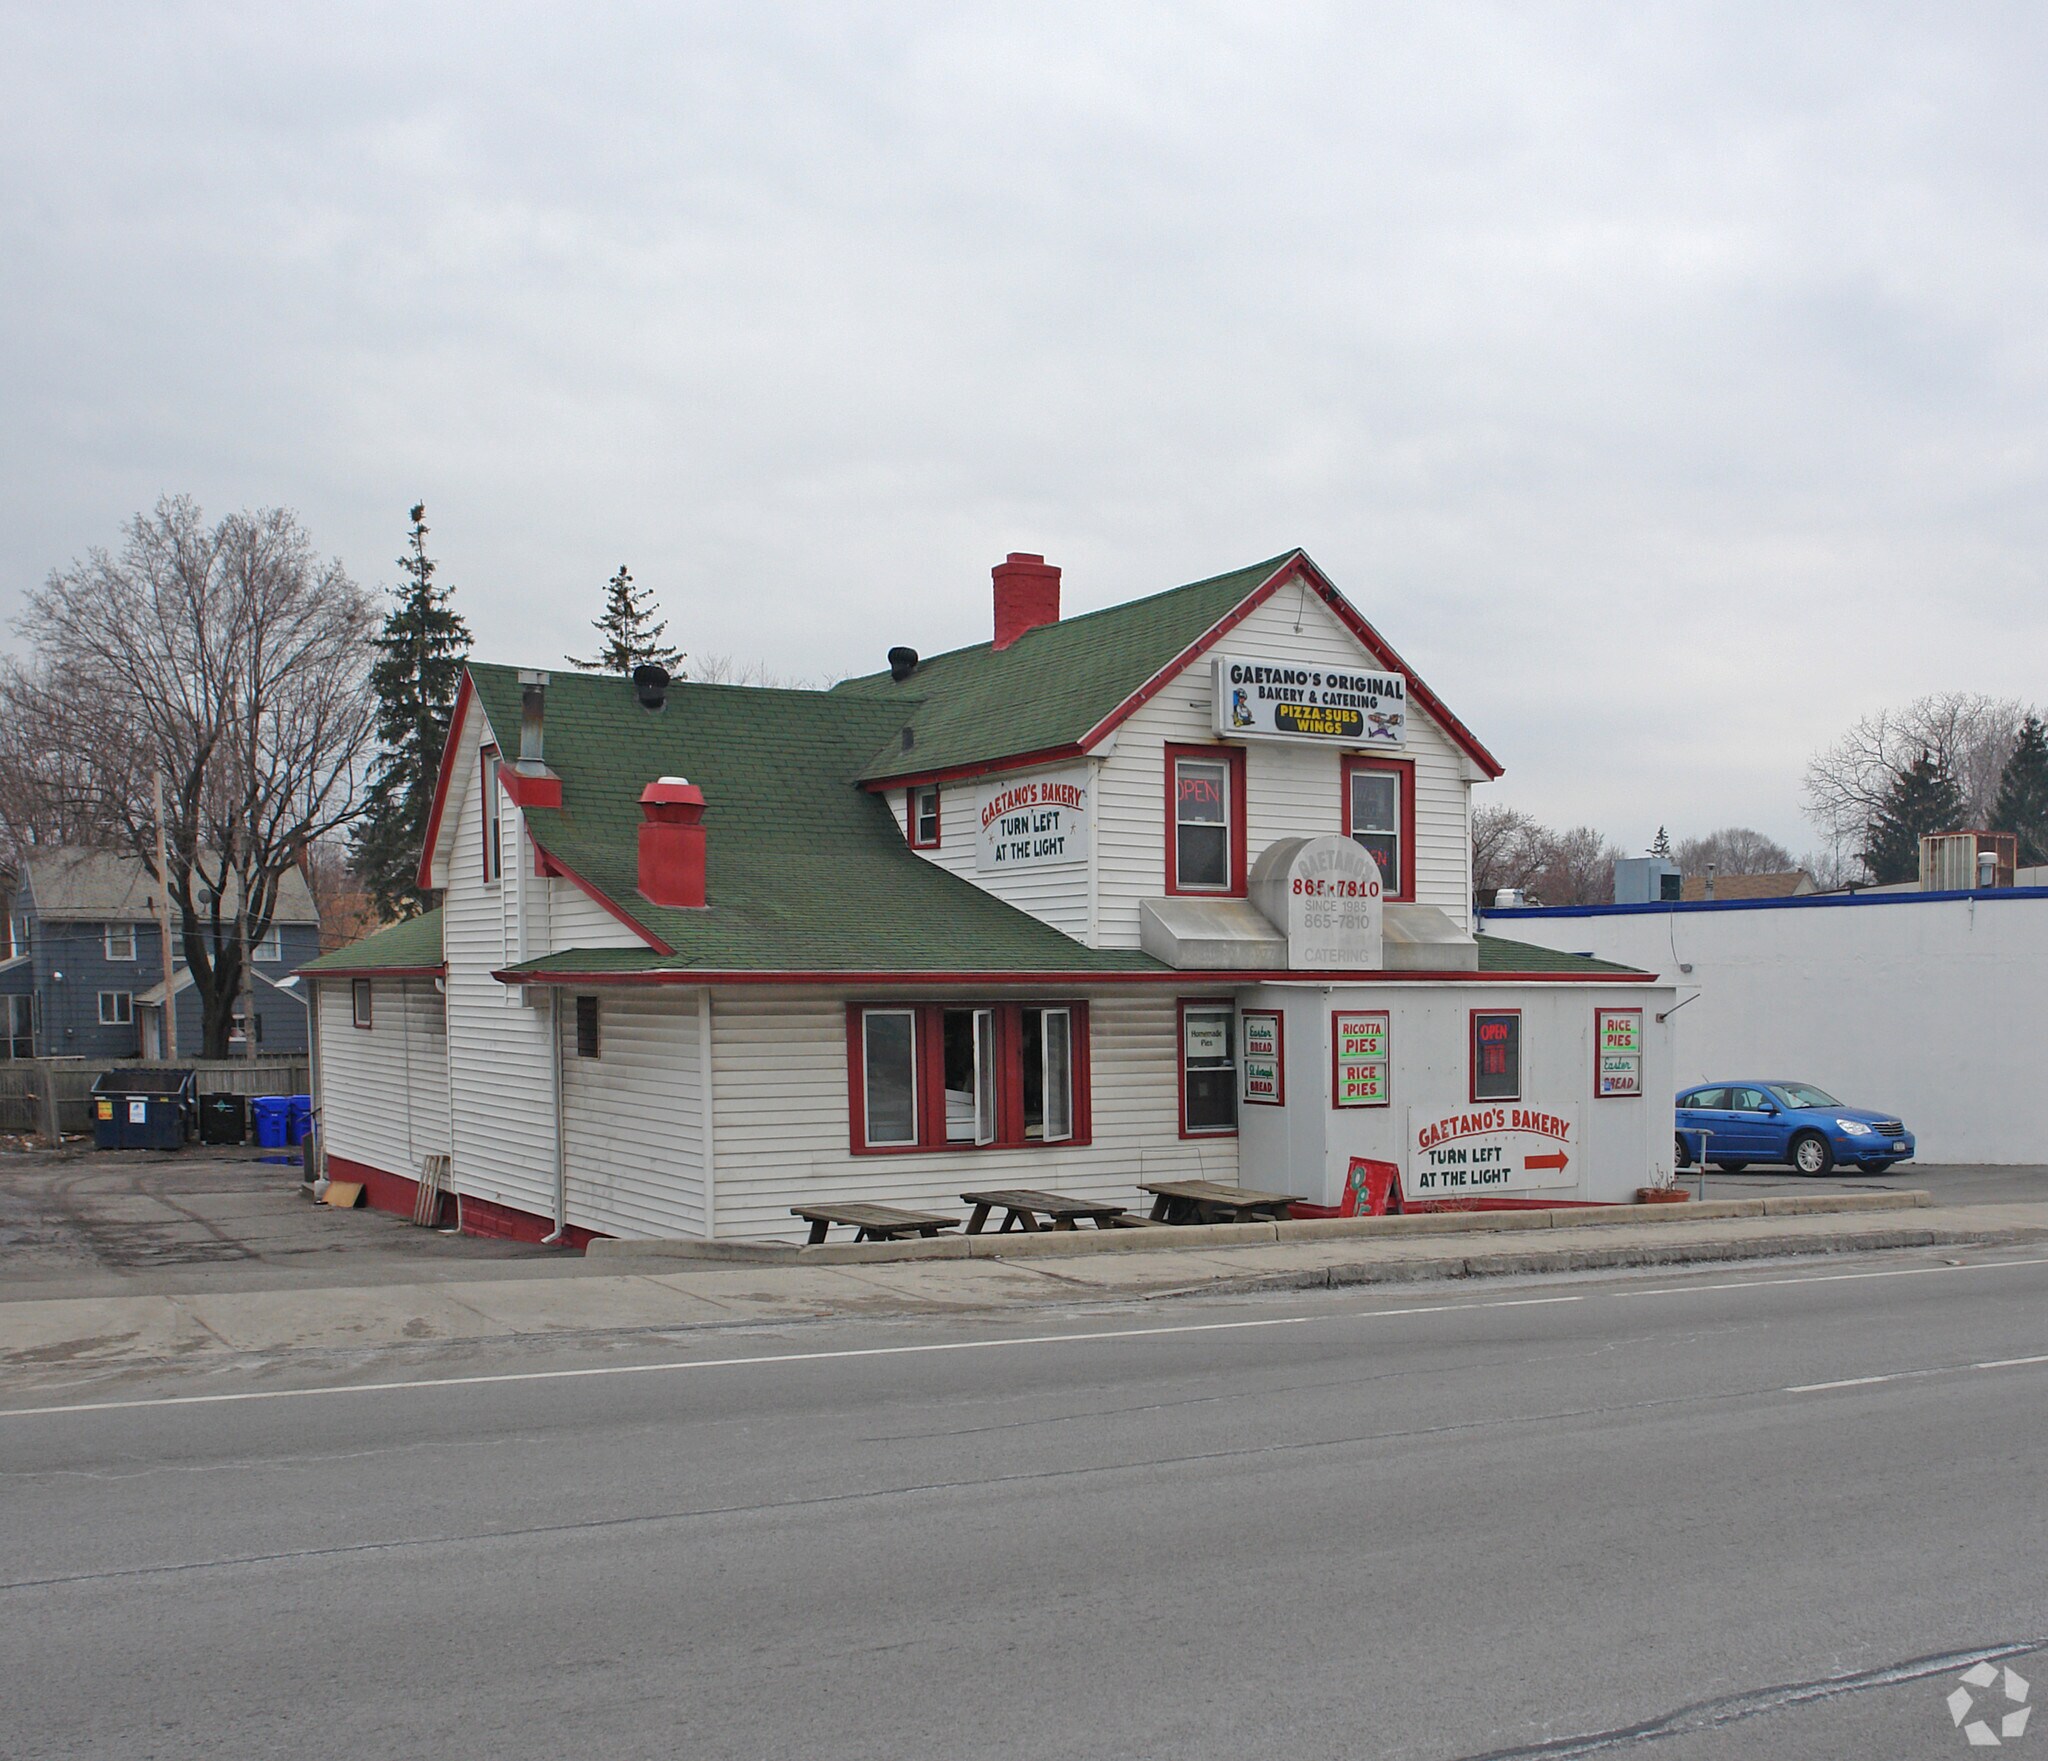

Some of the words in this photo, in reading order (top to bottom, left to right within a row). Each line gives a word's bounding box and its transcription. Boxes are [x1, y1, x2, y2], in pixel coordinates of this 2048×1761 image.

[1230, 665, 1321, 687] GAETANO'S
[1326, 674, 1404, 700] ORIGINAL
[1258, 686, 1305, 703] BAKERY
[1309, 691, 1318, 704] &
[1322, 692, 1378, 709] CATERING
[1297, 719, 1342, 735] WINGS
[982, 784, 1038, 826] GAETANO'S
[1041, 783, 1082, 807] BAKERY
[1000, 816, 1029, 837] TURN
[1033, 811, 1060, 833] LEFT
[995, 843, 1007, 862] AT
[1010, 841, 1030, 860] THE
[1034, 836, 1065, 857] LIGHT
[1305, 899, 1337, 912] SINCE
[1342, 901, 1367, 913] 1985
[1304, 914, 1370, 929] 865-7810
[1304, 948, 1369, 963] CATERING
[1342, 1023, 1382, 1035] RICOTTA
[1480, 1024, 1508, 1040] OPEN
[1607, 1019, 1632, 1032] RICE
[1250, 1041, 1273, 1053] BREAD
[1345, 1038, 1377, 1053] PIES
[1607, 1034, 1632, 1046] PIES
[1347, 1066, 1376, 1080] RICE
[1250, 1081, 1273, 1093] BREAD
[1347, 1082, 1377, 1096] PIES
[1418, 1108, 1505, 1148] GAETANO'S
[1511, 1109, 1571, 1138] BAKERY
[1428, 1148, 1467, 1166] TURN
[1472, 1147, 1502, 1163] LEFT
[1419, 1172, 1437, 1188] AT
[1441, 1171, 1467, 1186] THE
[1471, 1168, 1511, 1185] LIGHT
